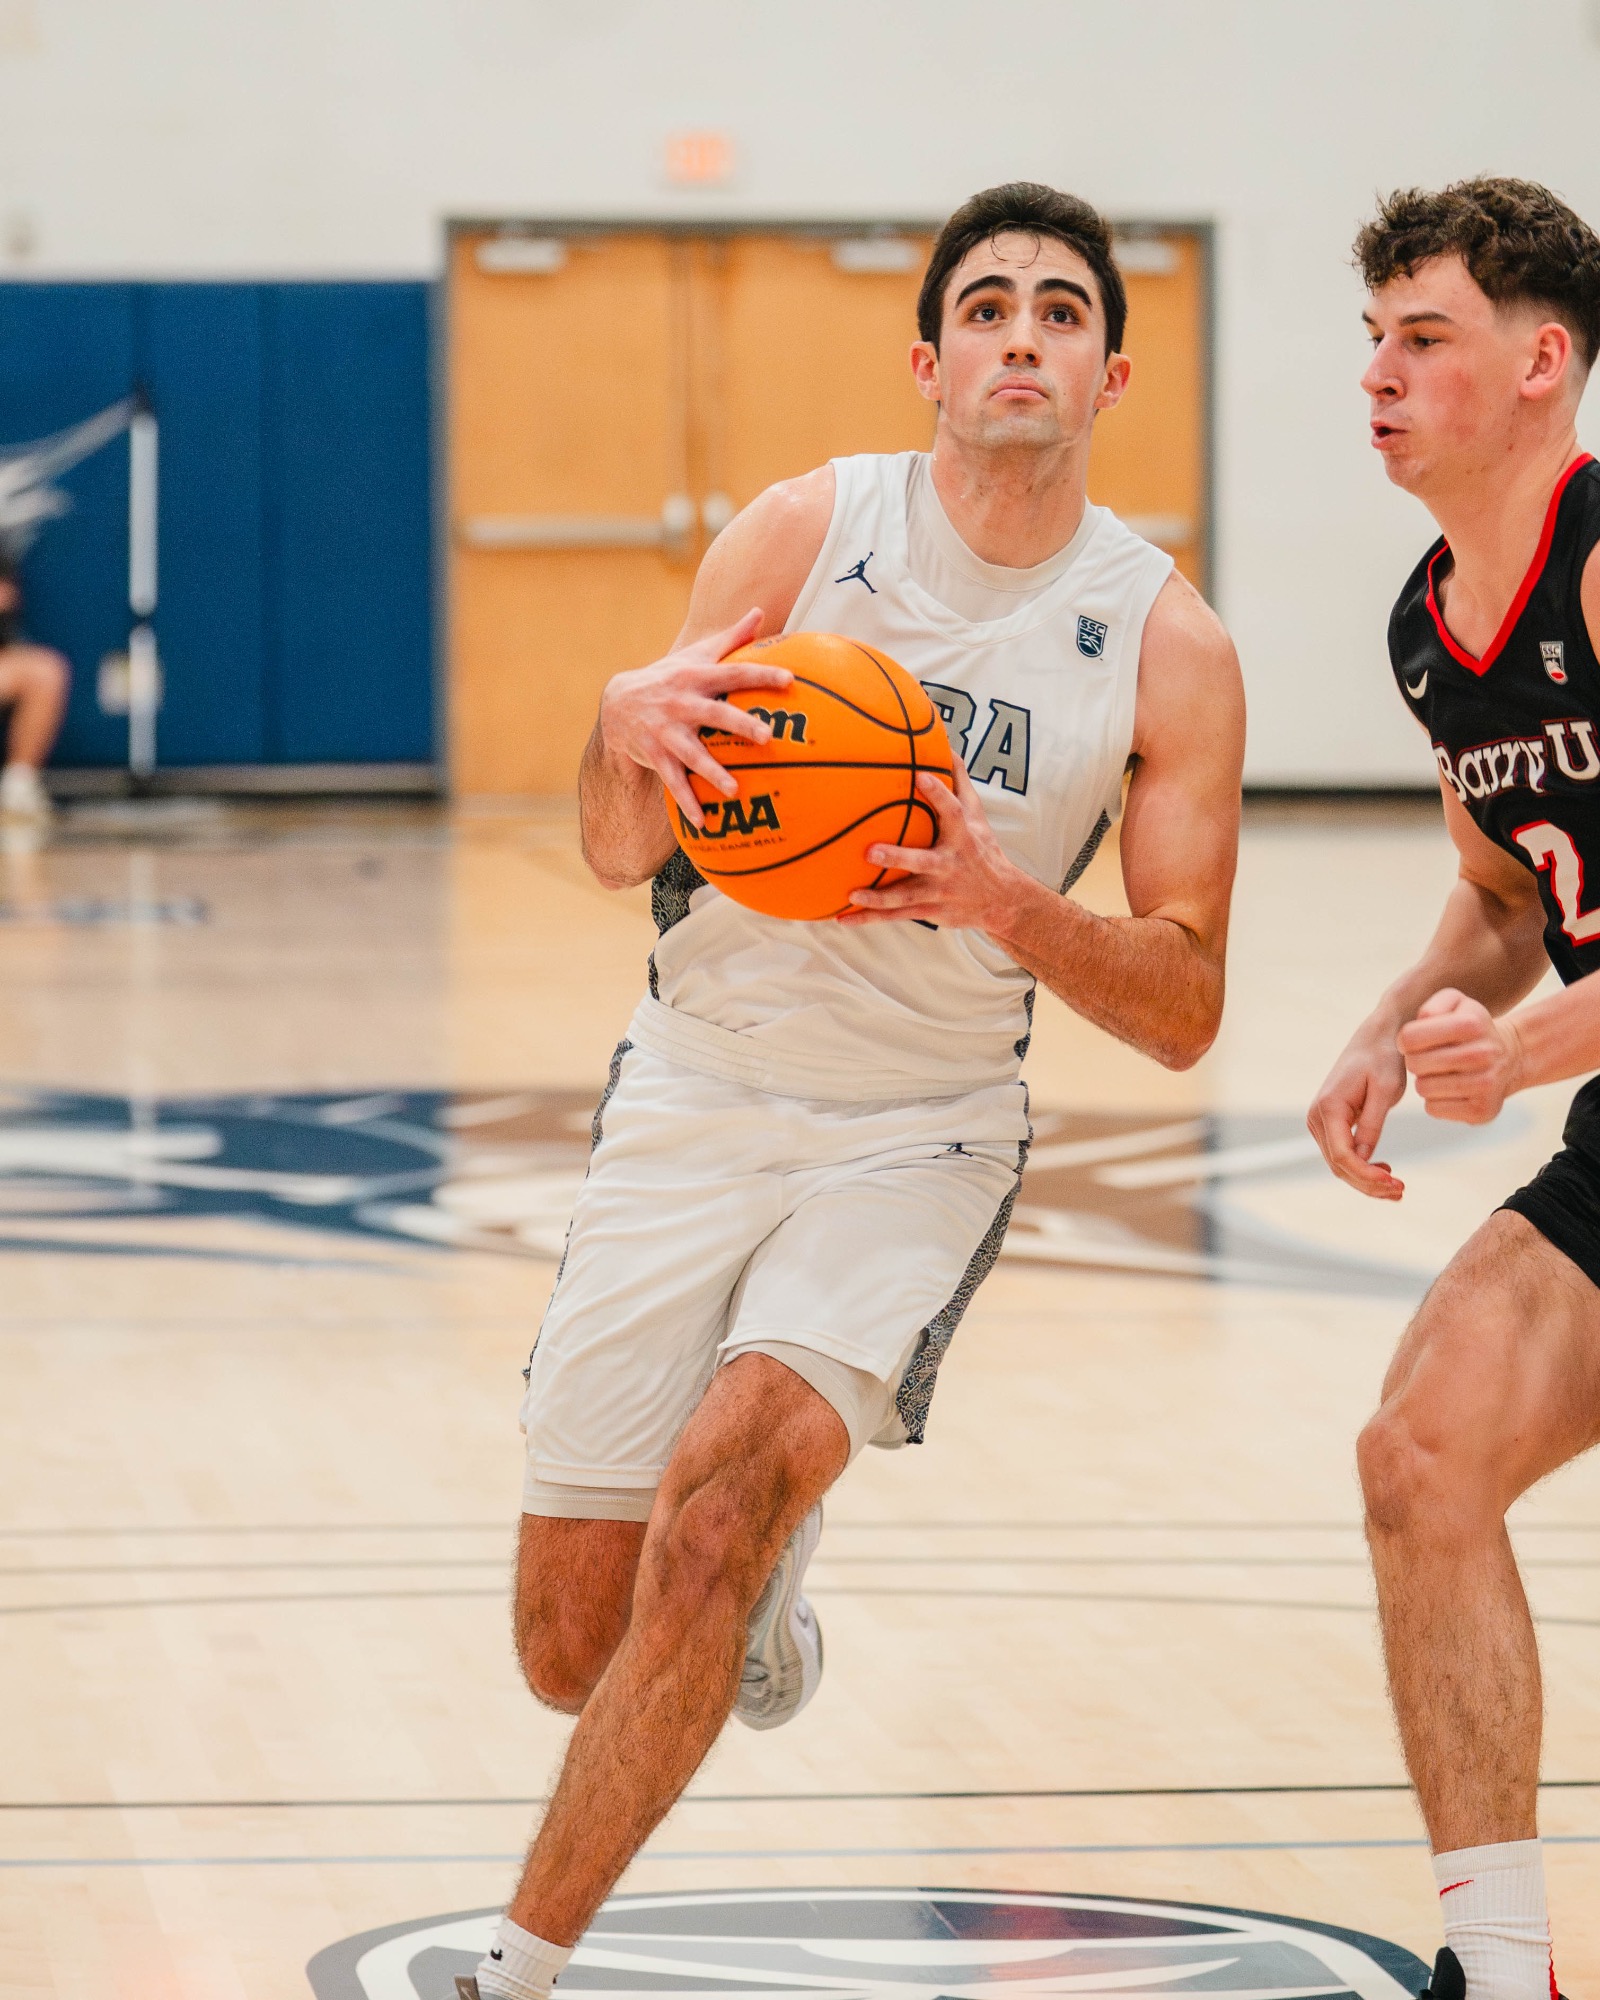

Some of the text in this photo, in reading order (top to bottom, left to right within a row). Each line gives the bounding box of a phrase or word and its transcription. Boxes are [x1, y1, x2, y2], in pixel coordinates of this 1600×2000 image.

[1080, 619, 1105, 636] SSC
[676, 795, 781, 840] NCAA
[1511, 819, 1600, 947] 2
